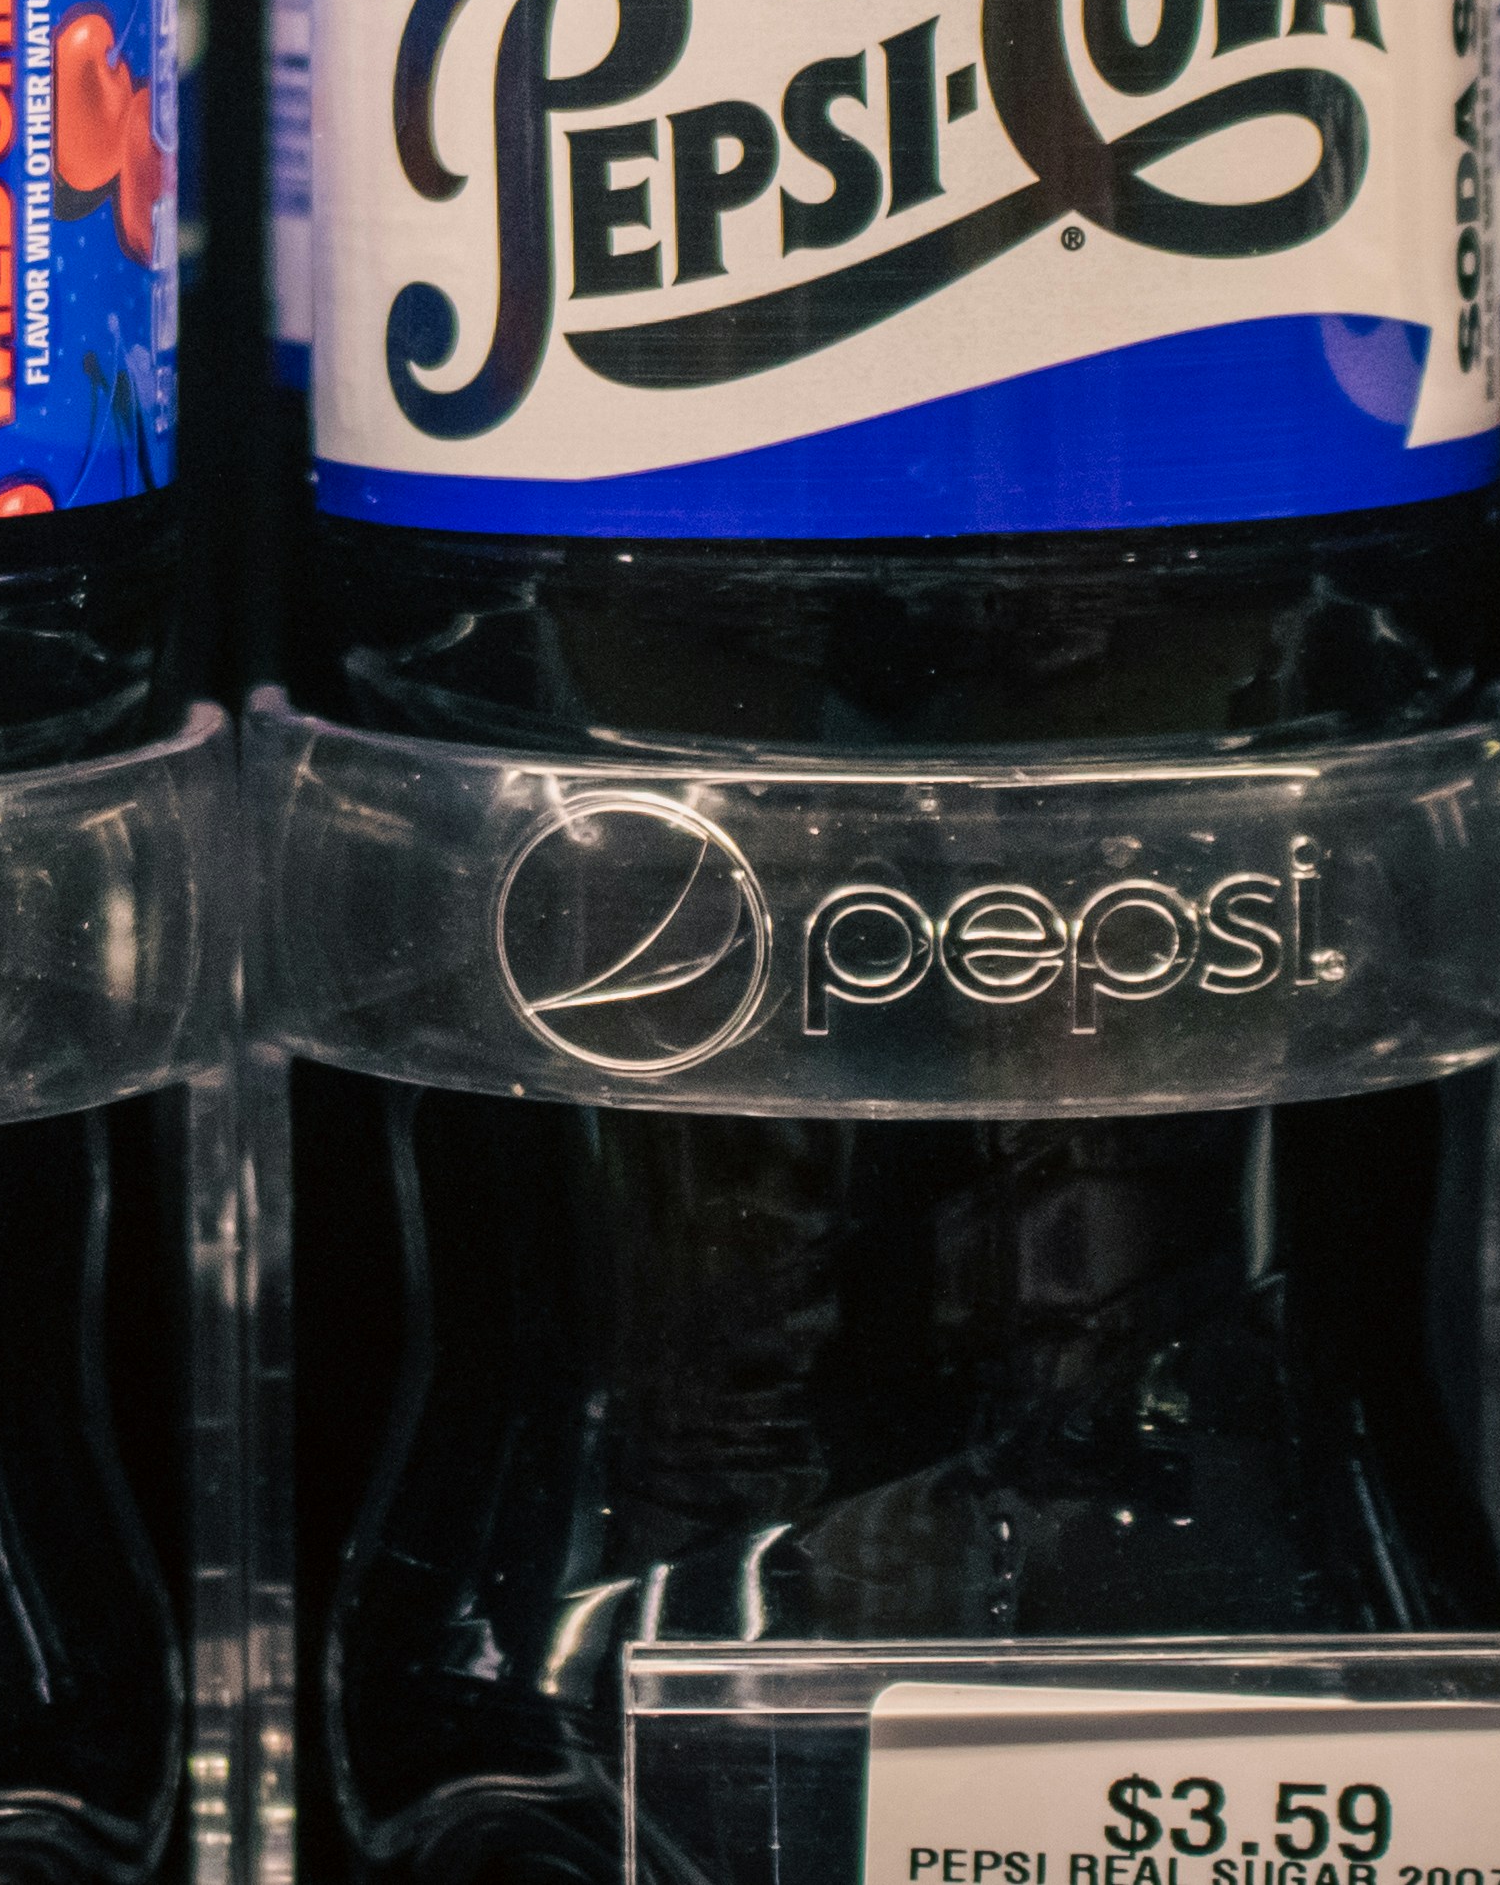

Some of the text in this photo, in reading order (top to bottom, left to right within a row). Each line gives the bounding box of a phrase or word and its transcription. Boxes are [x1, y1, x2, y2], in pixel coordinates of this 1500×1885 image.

[26, 75, 52, 176] OTHER
[26, 181, 51, 263] WITH
[1453, 77, 1482, 376] SODA
[26, 269, 51, 385] FLAVOR
[803, 835, 1323, 1037] pepsi
[909, 1847, 1047, 1885] PEPSI
[1069, 1853, 1179, 1885] REAL
[1212, 1858, 1378, 1885] SUGAR
[1103, 1773, 1394, 1863] $3.59
